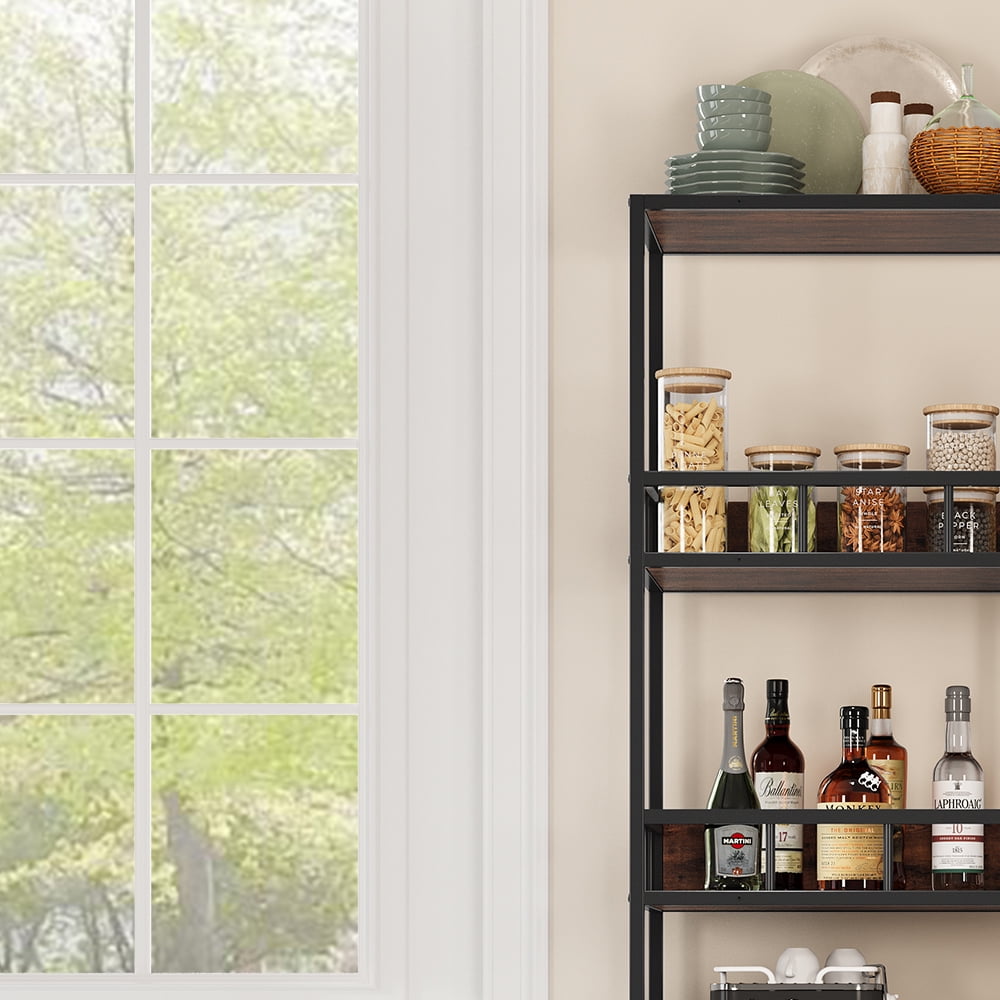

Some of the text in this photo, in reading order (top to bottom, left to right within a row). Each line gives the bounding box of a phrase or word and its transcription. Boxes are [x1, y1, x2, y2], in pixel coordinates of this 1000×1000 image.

[941, 511, 976, 519] BACK
[938, 521, 979, 529] PPPER
[934, 798, 982, 809] LAPHROAIG
[952, 824, 963, 834] 10
[778, 832, 788, 842] 17
